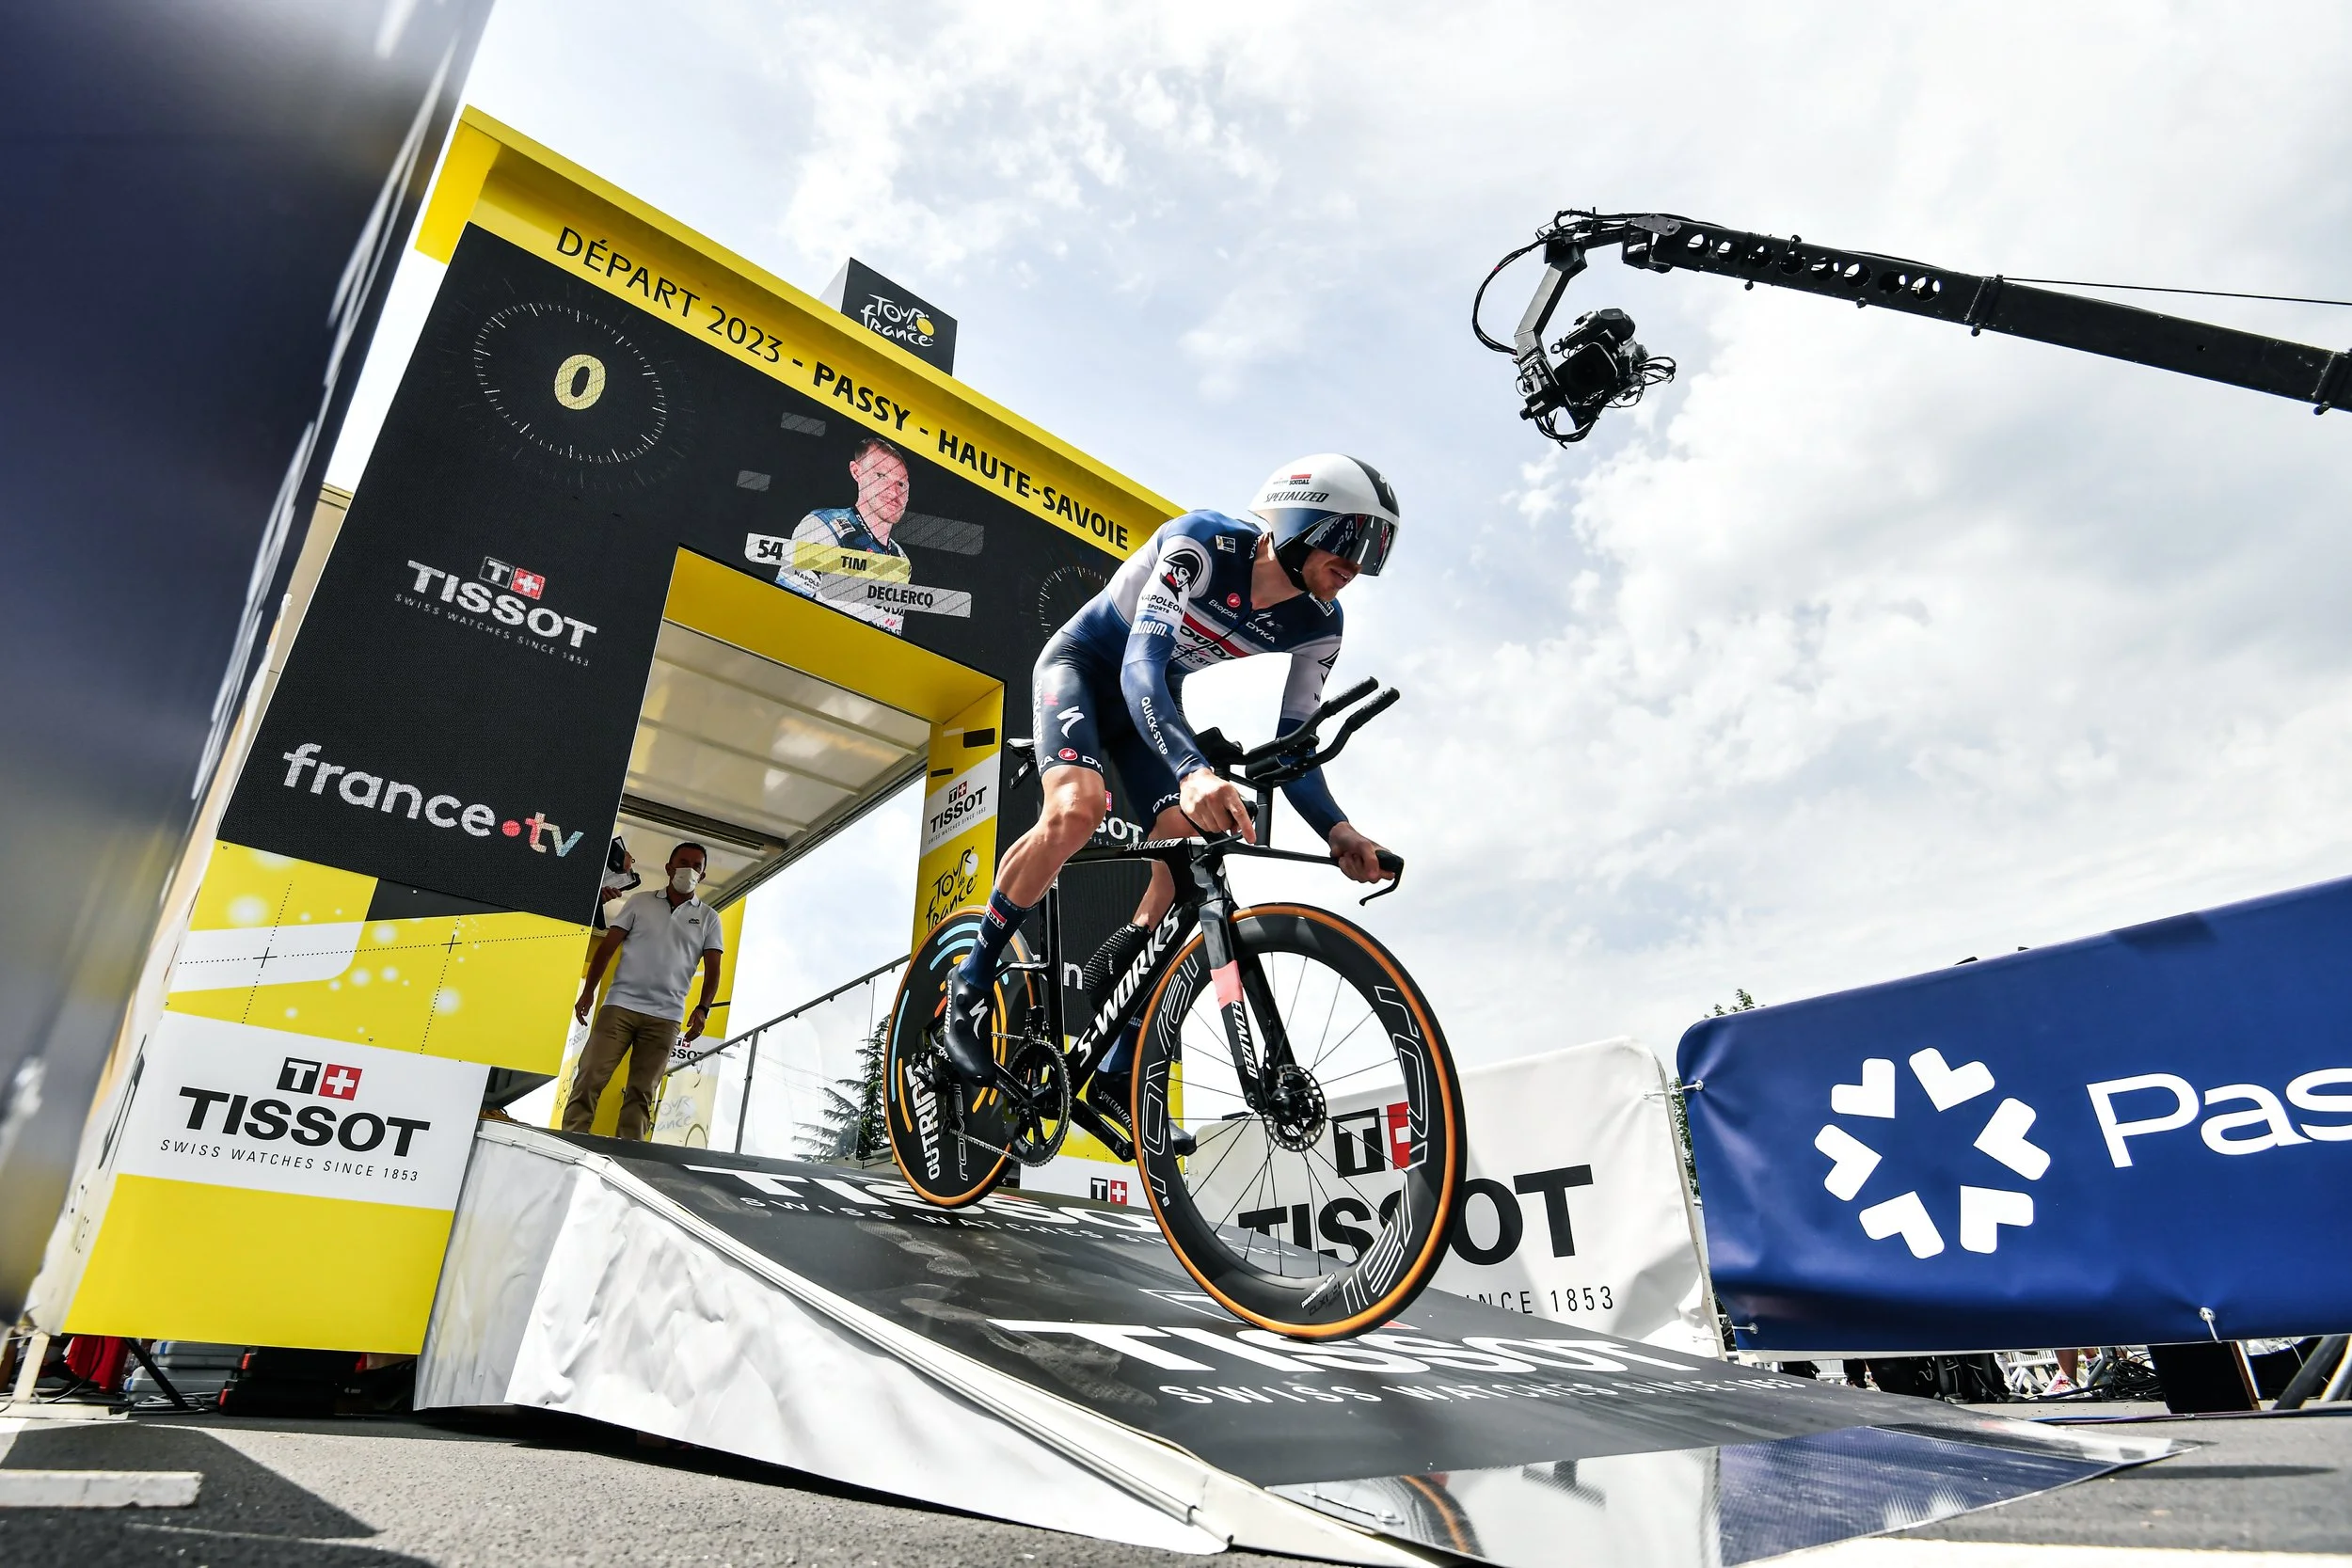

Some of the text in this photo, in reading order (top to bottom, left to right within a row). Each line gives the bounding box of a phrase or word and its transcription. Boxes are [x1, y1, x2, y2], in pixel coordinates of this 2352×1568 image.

[868, 293, 930, 325] TOUR
[906, 323, 918, 332] de
[553, 354, 607, 411] 0
[556, 226, 700, 318] DÉPART
[707, 306, 782, 364] 2023
[813, 361, 912, 431] PASSY
[938, 428, 1129, 552] HAUTE-SAVOIE
[1264, 491, 1330, 503] SPECIALIZED
[756, 539, 784, 561] 54
[840, 555, 867, 572] TIM
[407, 560, 598, 648] TISSOT
[866, 584, 934, 608] DECLERCQ
[1140, 594, 1184, 616] NAPOLEON
[1147, 603, 1170, 614] SPORTS
[1208, 598, 1240, 621] Ekopak
[394, 593, 440, 615] SWISS
[447, 611, 511, 640] WATCHES
[516, 635, 556, 656] SINCE
[1245, 621, 1276, 643] DYKA
[930, 785, 987, 833] TISSOT
[1152, 792, 1181, 814] DYK
[1124, 837, 1184, 852] SPECIALIZED
[931, 846, 975, 904] TOUR
[944, 978, 953, 1034] SPECIALIZED
[1076, 910, 1182, 1068] S-WORKS
[1231, 1001, 1260, 1080] ECIALIZED
[179, 1085, 431, 1157] TISSOT
[1098, 1090, 1133, 1131] SPECIALIZE
[160, 1139, 419, 1181] SWISS WATCHES SINCE 1853
[739, 1196, 896, 1220] SWISS
[913, 1213, 1104, 1239] WATCHES
[1238, 1164, 1594, 1266] TISOT
[1550, 1285, 1614, 1313] 1853
[985, 1318, 1700, 1373] TISSOT
[1158, 1385, 1382, 1405] SWISS
[1381, 1382, 1618, 1403] WATCHES
